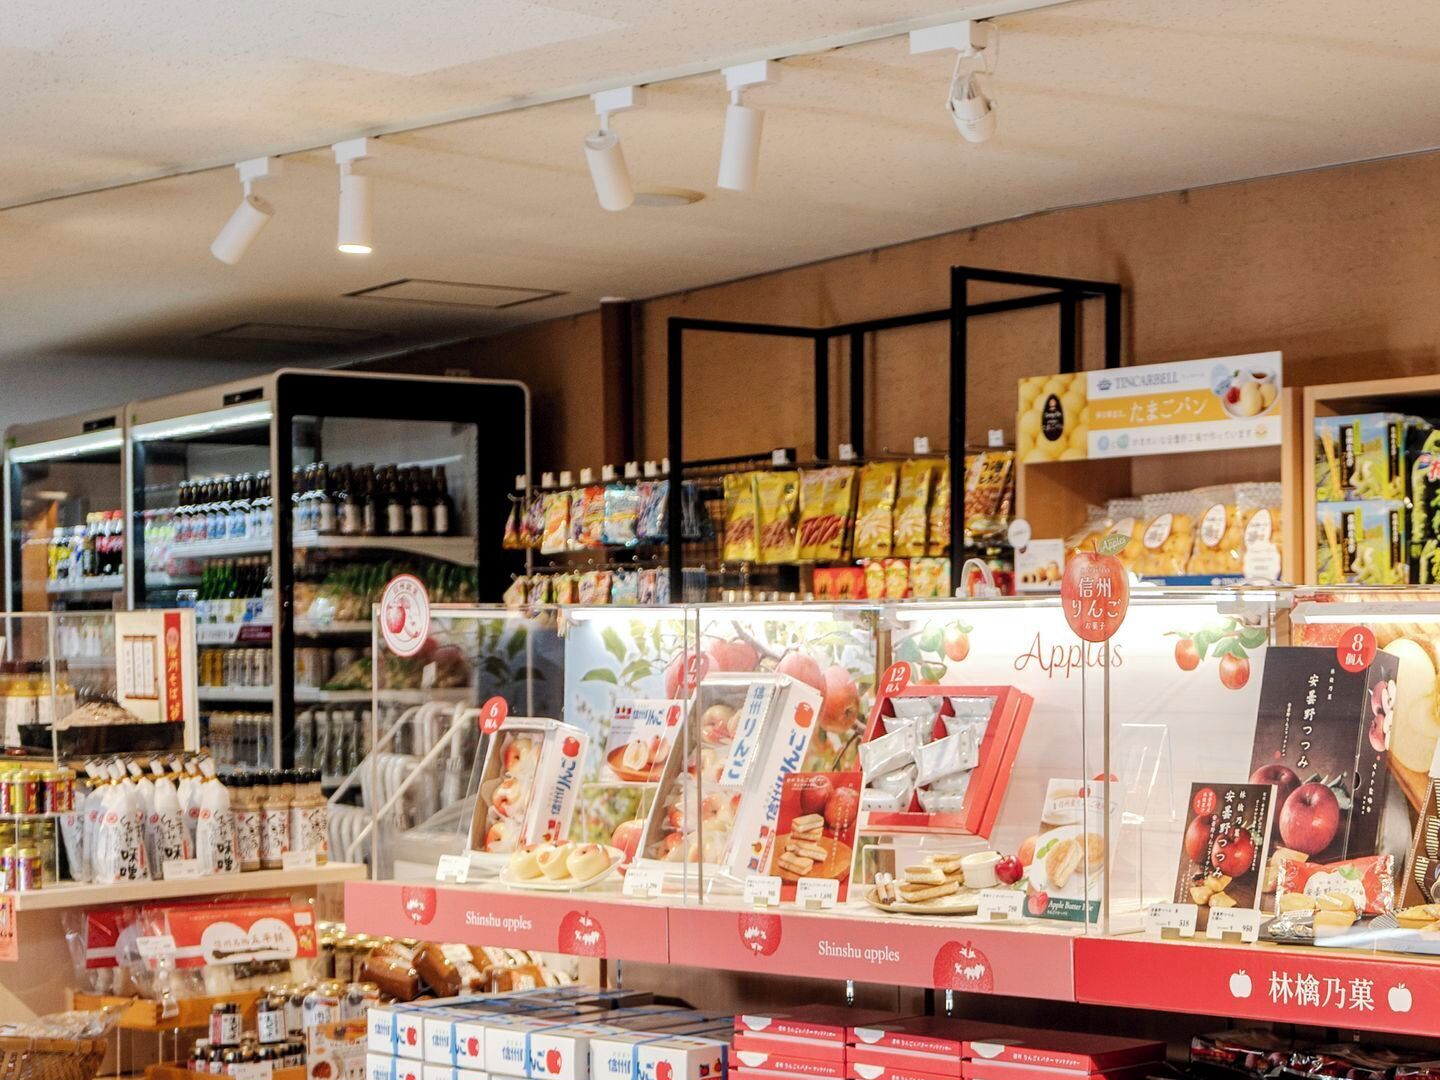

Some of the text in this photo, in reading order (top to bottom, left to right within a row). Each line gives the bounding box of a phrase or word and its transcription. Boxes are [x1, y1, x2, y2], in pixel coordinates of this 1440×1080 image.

[1115, 371, 1180, 390] TINCARBELL
[1129, 396, 1209, 424] たまごパン
[1078, 577, 1112, 598] 信州
[1072, 598, 1121, 618] りんご
[1351, 633, 1364, 653] 8
[1014, 631, 1124, 679] Apples
[1345, 653, 1365, 667] 個入
[888, 666, 905, 684] 12
[489, 703, 500, 718] 6
[1297, 673, 1320, 768] 安曇野つつみ
[727, 685, 766, 782] 信州りんご
[1213, 789, 1236, 878] 安曇野つつみ
[465, 910, 532, 932] Shinshu apples
[818, 940, 900, 964] Shinshu apples
[1268, 970, 1375, 1012] 林檎乃菓
